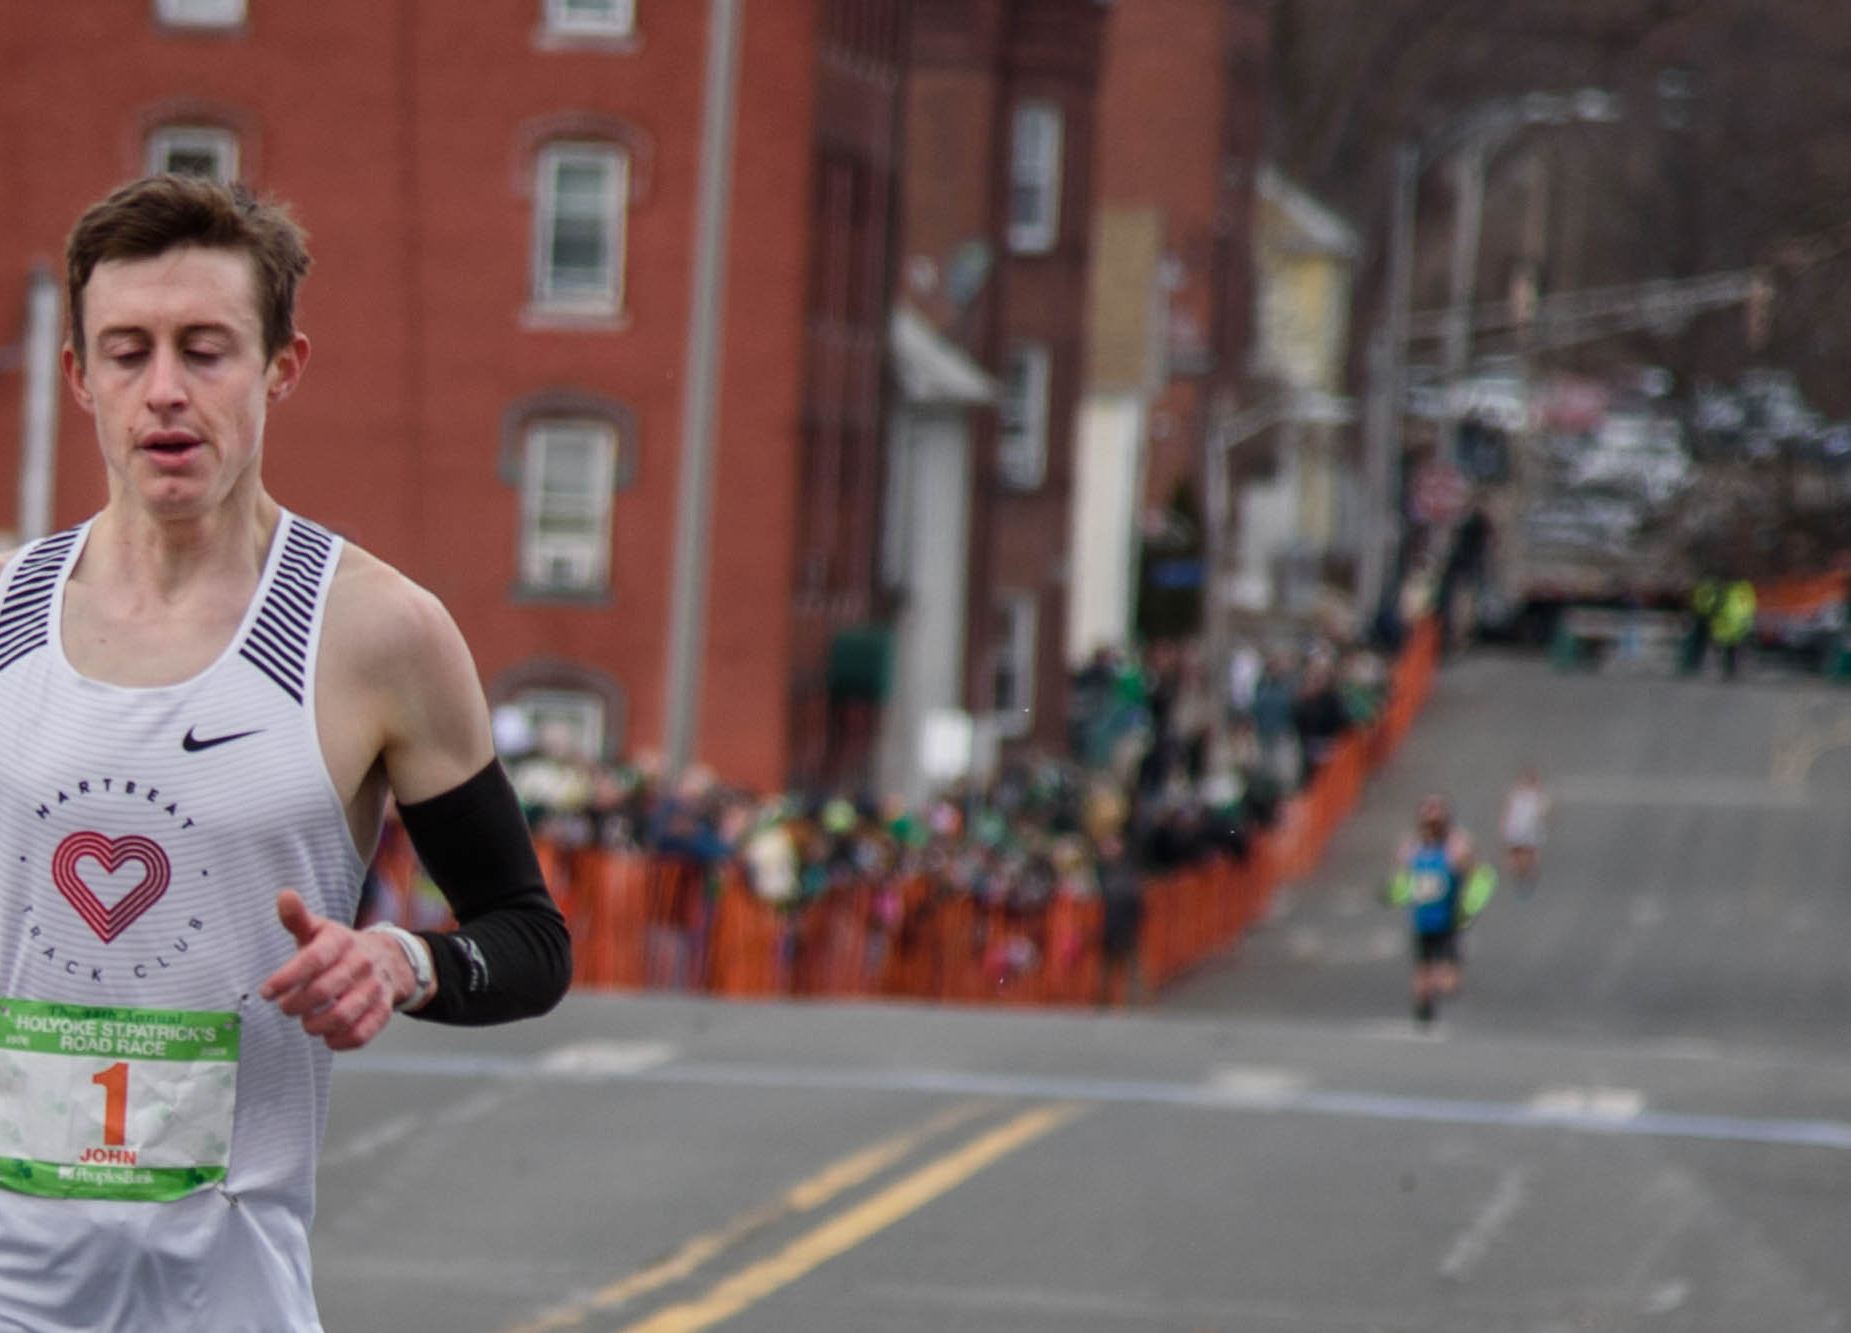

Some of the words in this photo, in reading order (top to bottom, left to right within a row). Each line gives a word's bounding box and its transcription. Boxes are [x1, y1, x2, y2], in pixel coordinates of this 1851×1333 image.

[35, 777, 196, 830] HARTBEAT
[22, 904, 103, 983] TRACK
[133, 917, 204, 979] CLUB
[16, 1015, 97, 1035] HOLYOKE
[60, 1035, 113, 1053] ROAD
[116, 1038, 166, 1057] RACE
[91, 1062, 130, 1147] 1
[79, 1147, 137, 1166] JOHN
